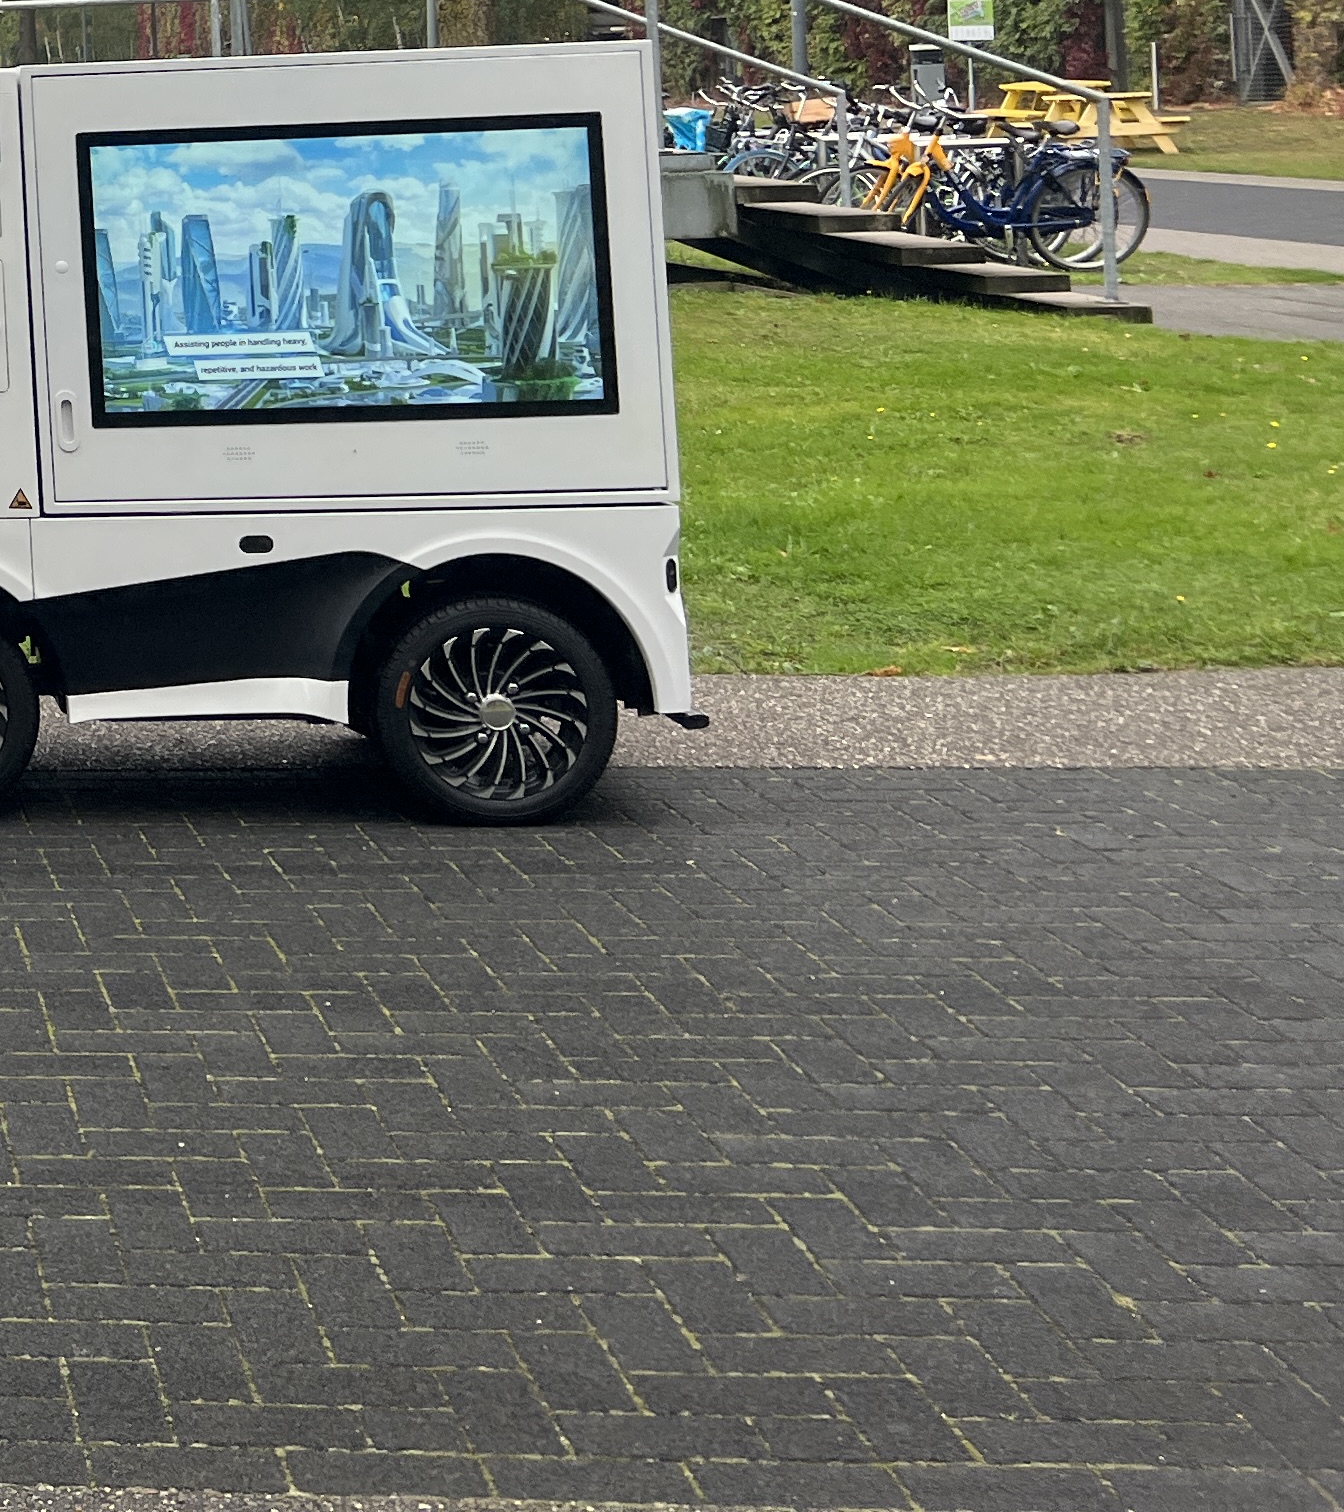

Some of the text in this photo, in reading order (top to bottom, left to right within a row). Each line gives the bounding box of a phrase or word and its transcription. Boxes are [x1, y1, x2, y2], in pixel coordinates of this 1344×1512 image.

[174, 337, 308, 349] Assisting people in handling heavy,
[200, 363, 318, 375] repetitive, and hazardous work
